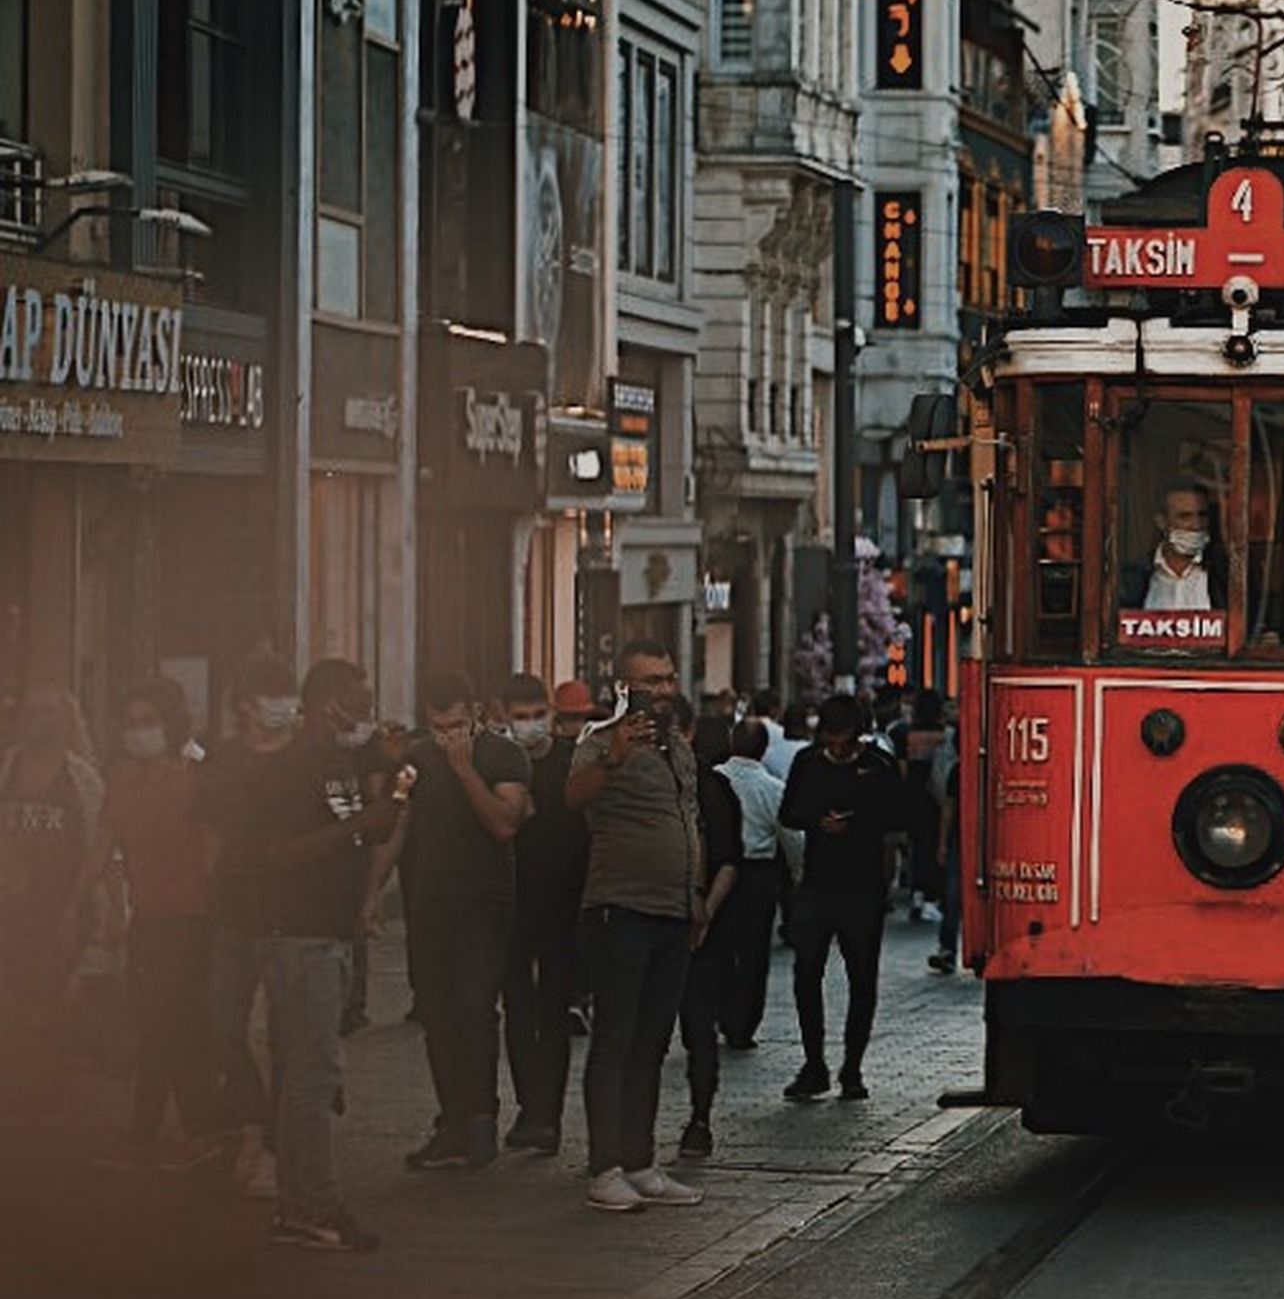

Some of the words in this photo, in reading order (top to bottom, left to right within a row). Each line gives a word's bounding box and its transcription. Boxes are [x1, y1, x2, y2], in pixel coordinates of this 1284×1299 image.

[1231, 178, 1252, 222] 4
[1087, 232, 1196, 276] TAKSİM
[50, 277, 182, 393] DÜNYASI
[1120, 615, 1223, 638] TAKSİM
[1007, 717, 1049, 762] 115
